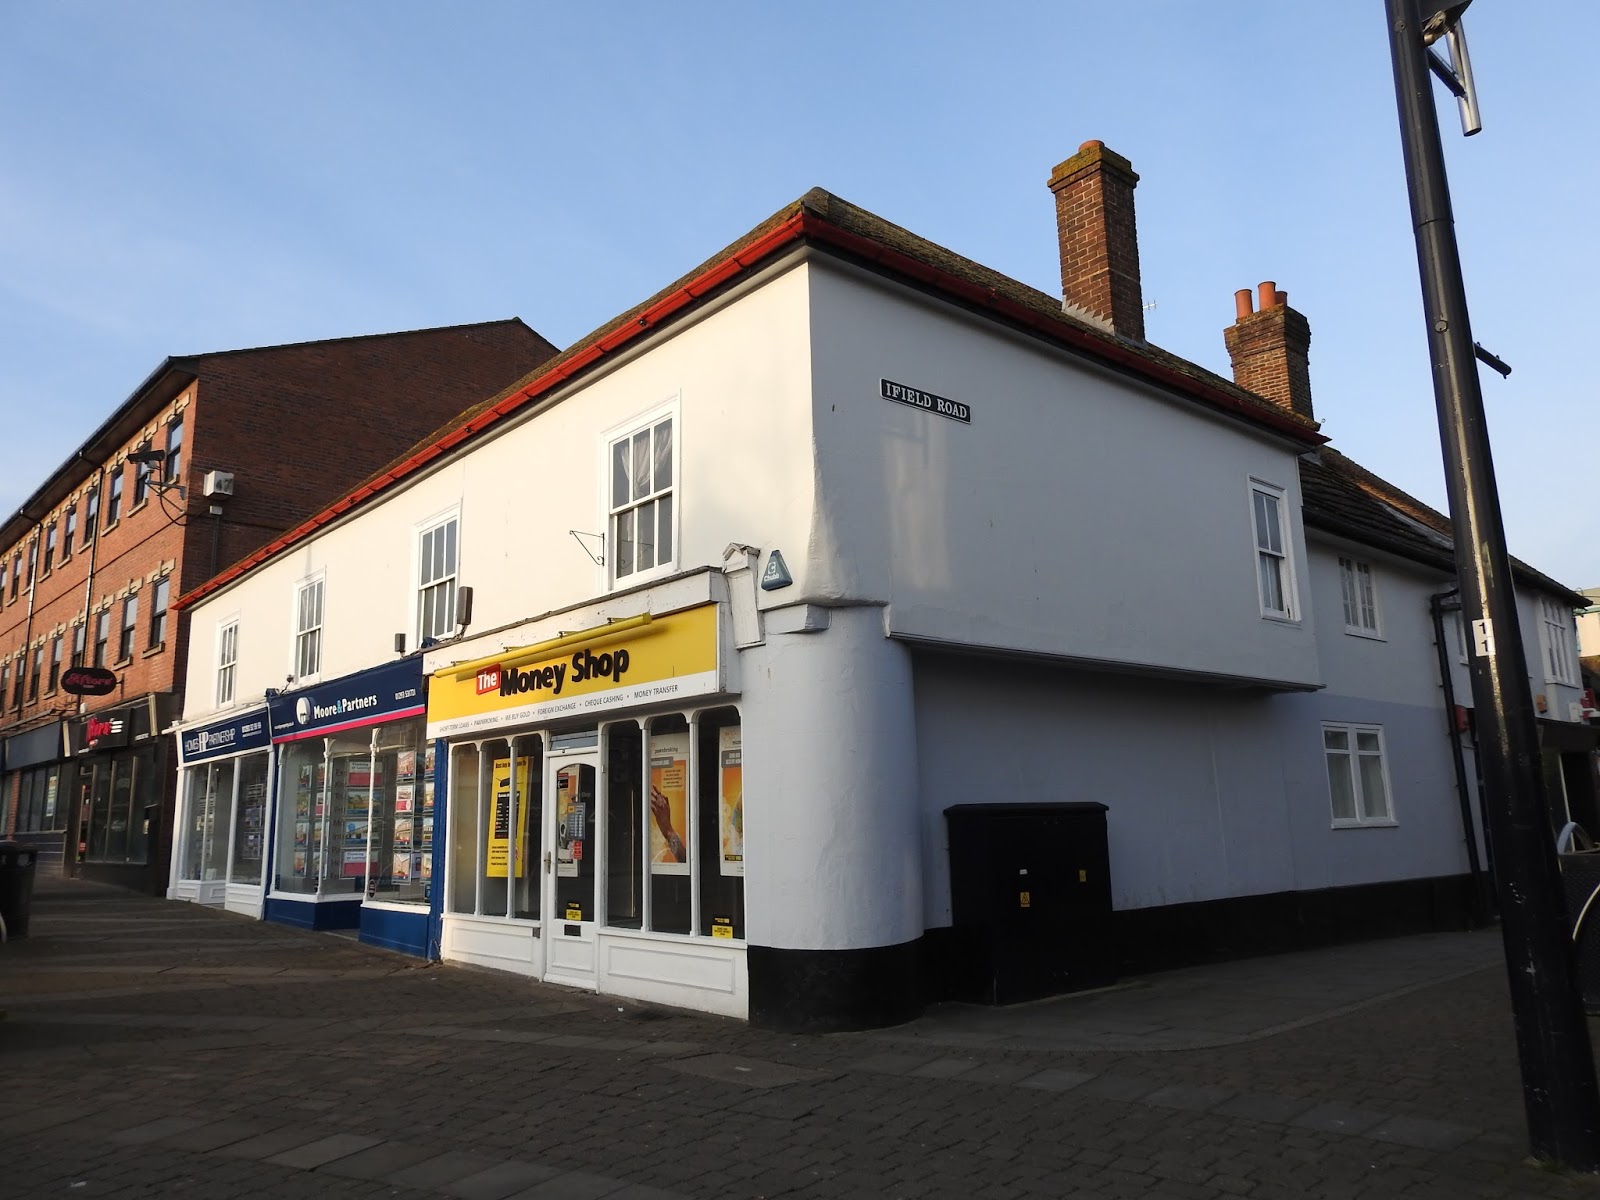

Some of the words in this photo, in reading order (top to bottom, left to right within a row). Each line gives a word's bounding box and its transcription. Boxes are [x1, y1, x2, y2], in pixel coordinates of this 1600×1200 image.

[886, 383, 932, 408] IFIELD
[936, 398, 967, 419] ROAD
[764, 573, 779, 581] Chubb
[478, 671, 497, 691] The
[500, 663, 567, 697] Money
[571, 649, 629, 683] Shop
[313, 694, 378, 719] Moore&Partners
[537, 705, 554, 715] FOREIGN
[554, 702, 577, 713] EXCHANGE
[584, 697, 602, 707] CHEQUE
[603, 694, 624, 704] CASHING
[634, 688, 652, 698] MONEY
[653, 684, 679, 696] TRANSFER
